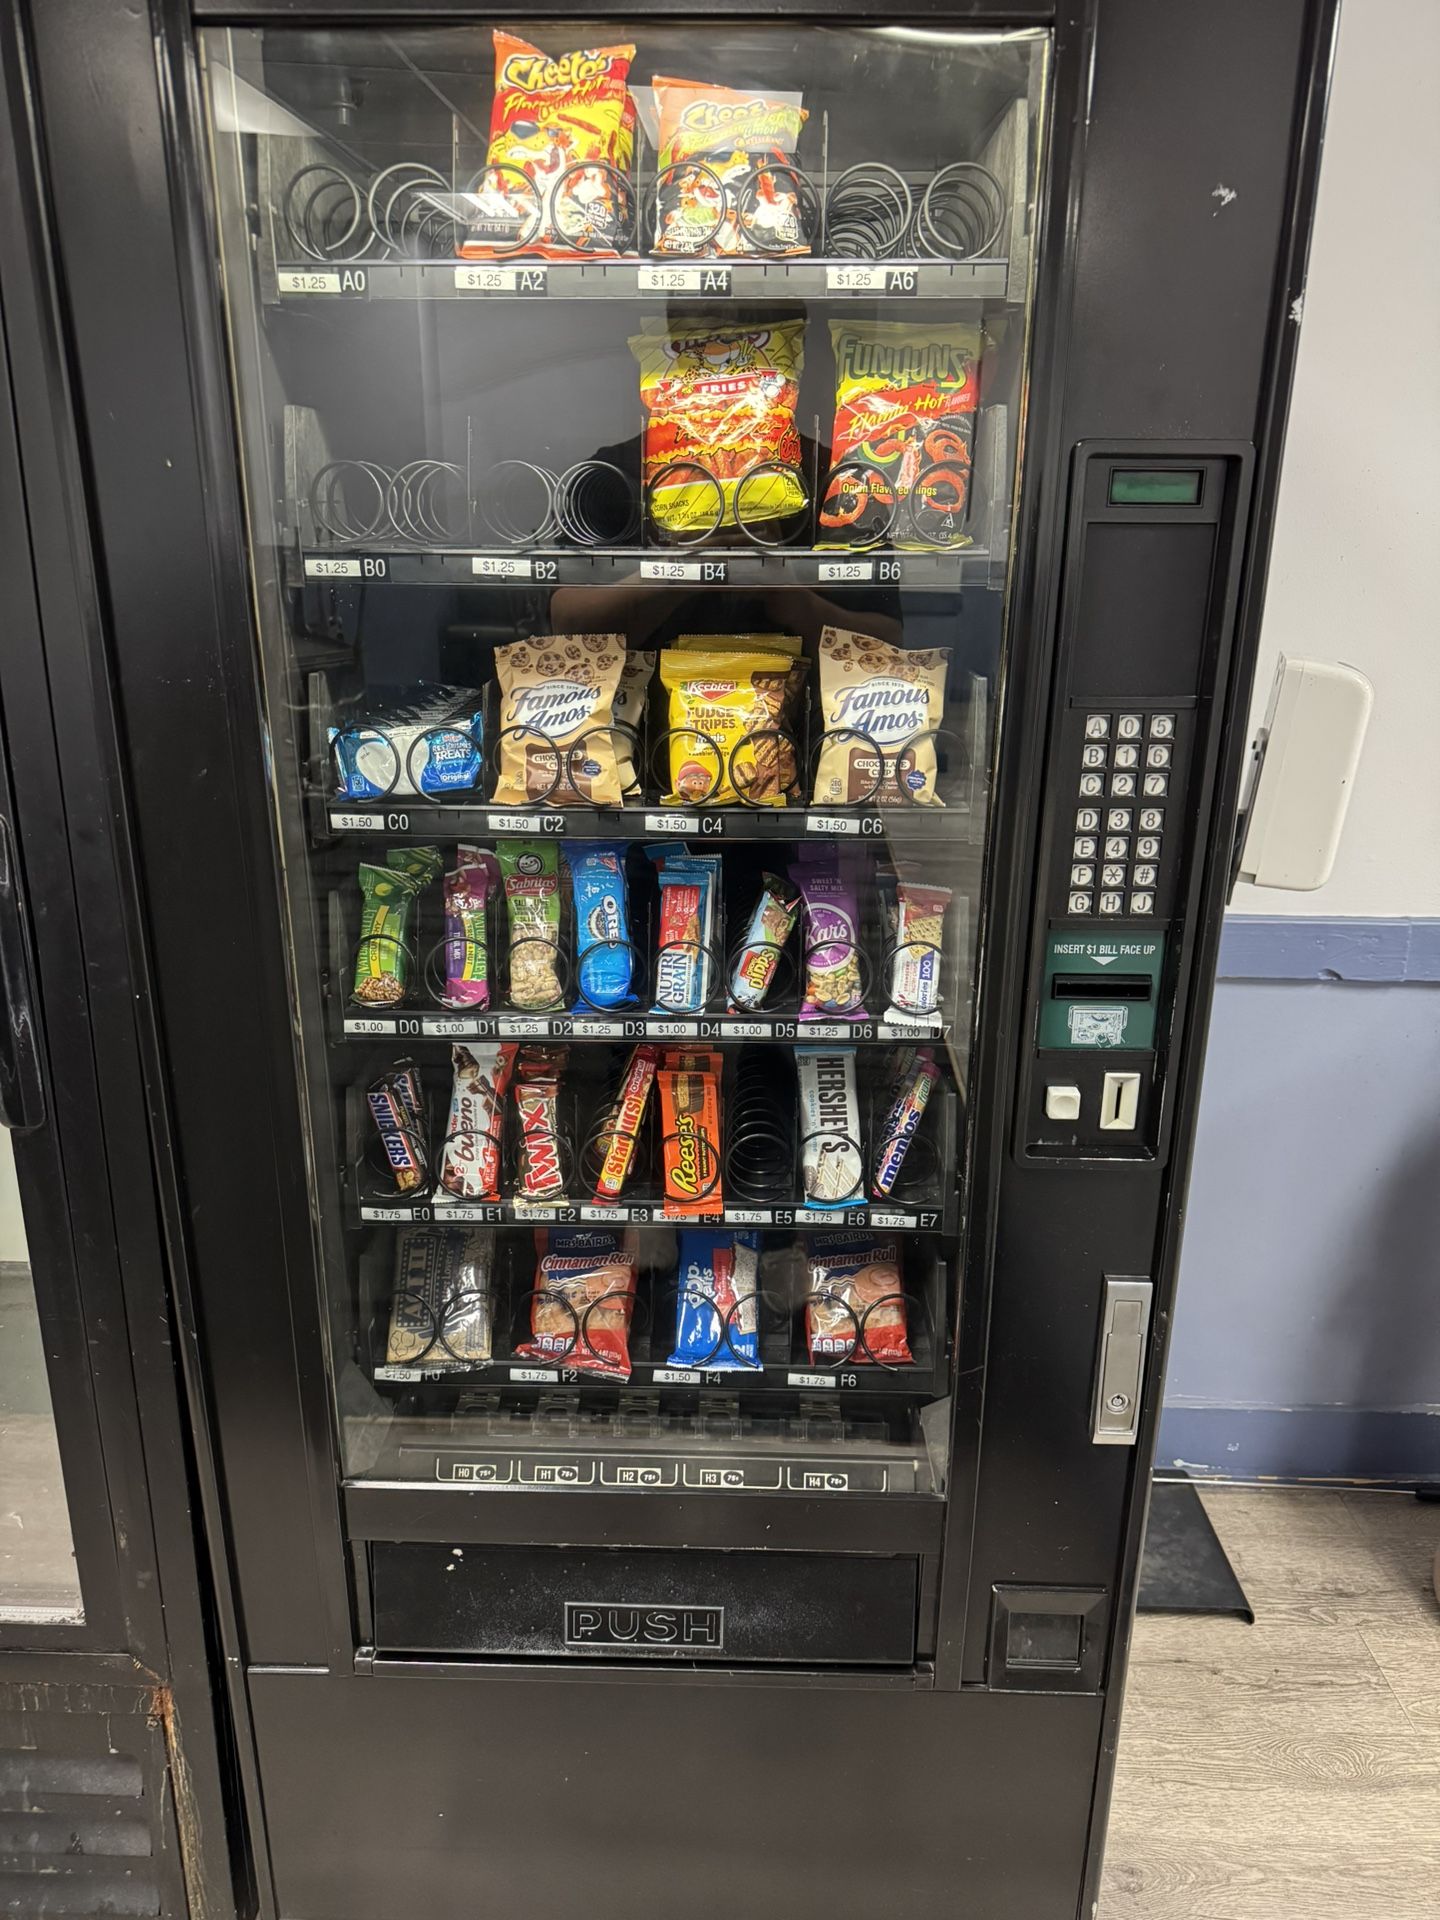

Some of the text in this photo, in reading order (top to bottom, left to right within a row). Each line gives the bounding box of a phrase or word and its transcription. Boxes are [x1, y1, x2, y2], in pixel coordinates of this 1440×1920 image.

[292, 271, 366, 290] $1.25 A0
[467, 271, 544, 290] $1.25 A2
[651, 271, 728, 290] $1.25 A4
[837, 270, 914, 290] $1.25 A6
[838, 333, 967, 389] FUNYUNS
[701, 380, 747, 394] FRIES
[914, 393, 945, 412] Hot
[842, 482, 938, 497] Onion ings
[316, 559, 386, 577] $1.25 B0
[483, 561, 557, 579] $1.25 B2
[652, 564, 726, 581] $1.25 B4
[828, 563, 901, 580] $1.25 B6
[506, 686, 601, 721] Famous
[830, 688, 930, 723] Famous
[512, 704, 590, 741] Amos
[837, 709, 924, 742] Amos
[1091, 719, 1166, 734] A 0 5
[434, 748, 472, 762] TREATS
[1089, 749, 1162, 763] B 1 6
[1086, 778, 1160, 793] C 2 7
[341, 813, 409, 830] $1.50 C0
[498, 816, 564, 832] $1.50 C2
[657, 817, 723, 834] $1.50 C4
[816, 818, 883, 835] $1.50 C6
[1082, 812, 1155, 827] D 3 8
[1081, 840, 1152, 855] E 4 9
[1079, 868, 1086, 882] F
[508, 877, 555, 891] Sabritas
[1075, 896, 1147, 910] G H J
[474, 912, 487, 943] NATUR
[370, 921, 382, 961] CRUNHY
[1054, 944, 1156, 955] INSERT $1 BILL FACE UP
[358, 942, 371, 976] NATUR
[922, 960, 931, 979] 100
[659, 952, 673, 1003] NUTRI
[354, 1019, 419, 1034] $1.00 D0
[435, 1020, 496, 1034] $1.00 D1
[509, 1020, 572, 1035] $1.25 D2
[582, 1021, 645, 1036] $1.25 D3
[658, 1022, 721, 1036] $1.00 D4
[733, 1023, 795, 1037] $1.00 D5
[809, 1024, 873, 1038] $1.25 D6
[891, 1027, 920, 1037] $1.00
[816, 1057, 850, 1153] HERSHEYS
[369, 1094, 412, 1167] SNICKERS
[454, 1096, 475, 1162] bueno
[606, 1095, 643, 1177] Starurst
[670, 1113, 699, 1195] Reese's
[880, 1109, 922, 1188] menos
[373, 1207, 430, 1220] $1.75 E0
[446, 1208, 502, 1221] $1.75 E1
[521, 1208, 576, 1221] $1.75 E2
[589, 1209, 649, 1221] $1.75 E3
[703, 1211, 720, 1224] E4
[734, 1211, 792, 1224] $1.75 E5
[804, 1212, 865, 1225] $1.75 E6
[877, 1214, 937, 1227] $1.75 E7
[871, 1245, 897, 1263] Roll
[541, 1252, 634, 1272] Cinnamon Roll
[520, 1369, 578, 1383] $1.75 F2
[664, 1371, 722, 1385] $1.50 F4
[799, 1374, 857, 1387] $1.75 F6
[458, 1468, 469, 1477] H0
[540, 1469, 551, 1479] H1
[622, 1471, 634, 1481] H2
[705, 1473, 717, 1483] H3
[809, 1477, 821, 1487] H4
[572, 1609, 716, 1642] PUSH
